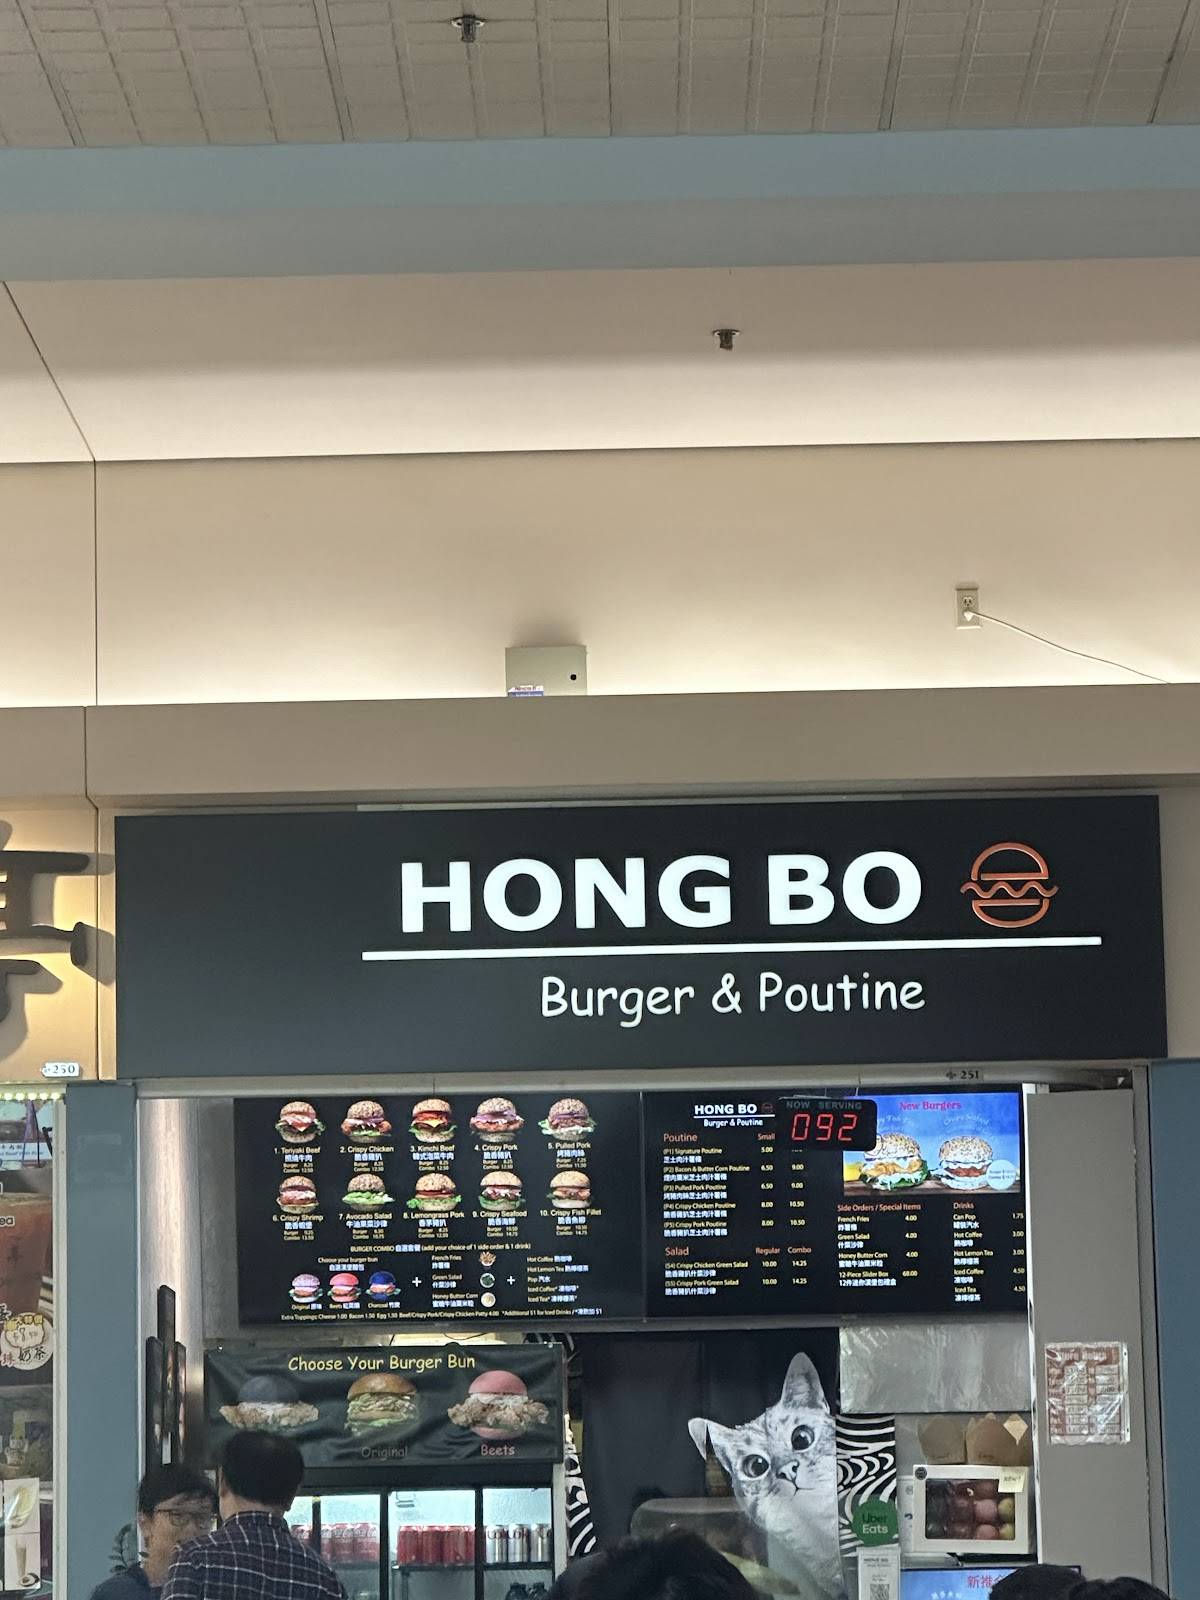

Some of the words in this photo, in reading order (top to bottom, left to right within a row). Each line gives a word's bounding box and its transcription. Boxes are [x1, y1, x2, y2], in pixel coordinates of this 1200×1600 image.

[400, 852, 733, 934] HONG
[768, 851, 922, 924] BO
[540, 976, 694, 1028] Burger
[712, 974, 742, 1013] &
[759, 971, 925, 1012] Poutine
[53, 1065, 75, 1073] 250
[960, 1071, 979, 1079] 251
[695, 1104, 734, 1115] HONG
[738, 1104, 757, 1114] BO
[786, 1101, 810, 1109] NOW
[900, 1102, 919, 1110] New
[922, 1101, 962, 1112] Burgers
[704, 1119, 728, 1128] Burger
[791, 1113, 857, 1141] 092
[664, 1133, 697, 1142] Poutine
[953, 1202, 974, 1210] Drinks
[665, 1247, 689, 1256] Salad
[288, 1357, 343, 1371] Choose
[347, 1356, 384, 1370] Your
[389, 1355, 442, 1373] Burger
[448, 1355, 475, 1368] Bun
[361, 1446, 408, 1458] Original
[480, 1445, 515, 1455] Beets
[862, 1514, 888, 1524] Uber
[862, 1524, 888, 1534] Eats
